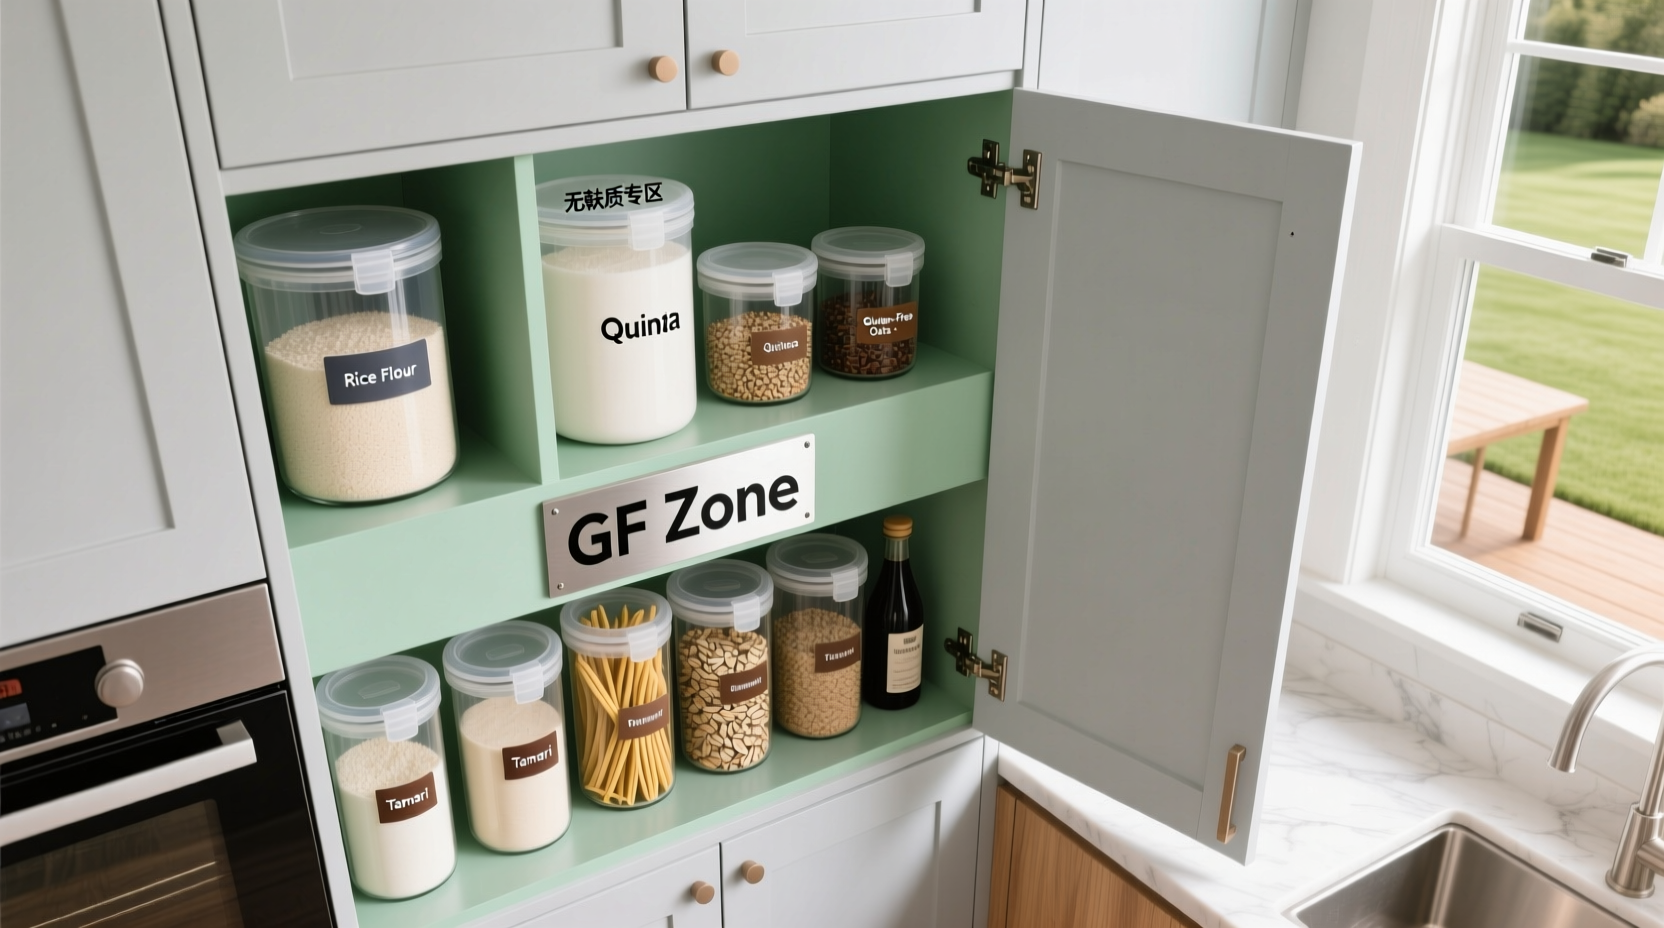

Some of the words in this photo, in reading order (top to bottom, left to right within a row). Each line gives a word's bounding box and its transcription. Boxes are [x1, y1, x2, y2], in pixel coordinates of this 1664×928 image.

[344, 371, 377, 388] Rice
[381, 364, 417, 382] Flour
[568, 499, 647, 566] GF
[664, 474, 799, 543] Zone
[511, 744, 552, 769] Tamari
